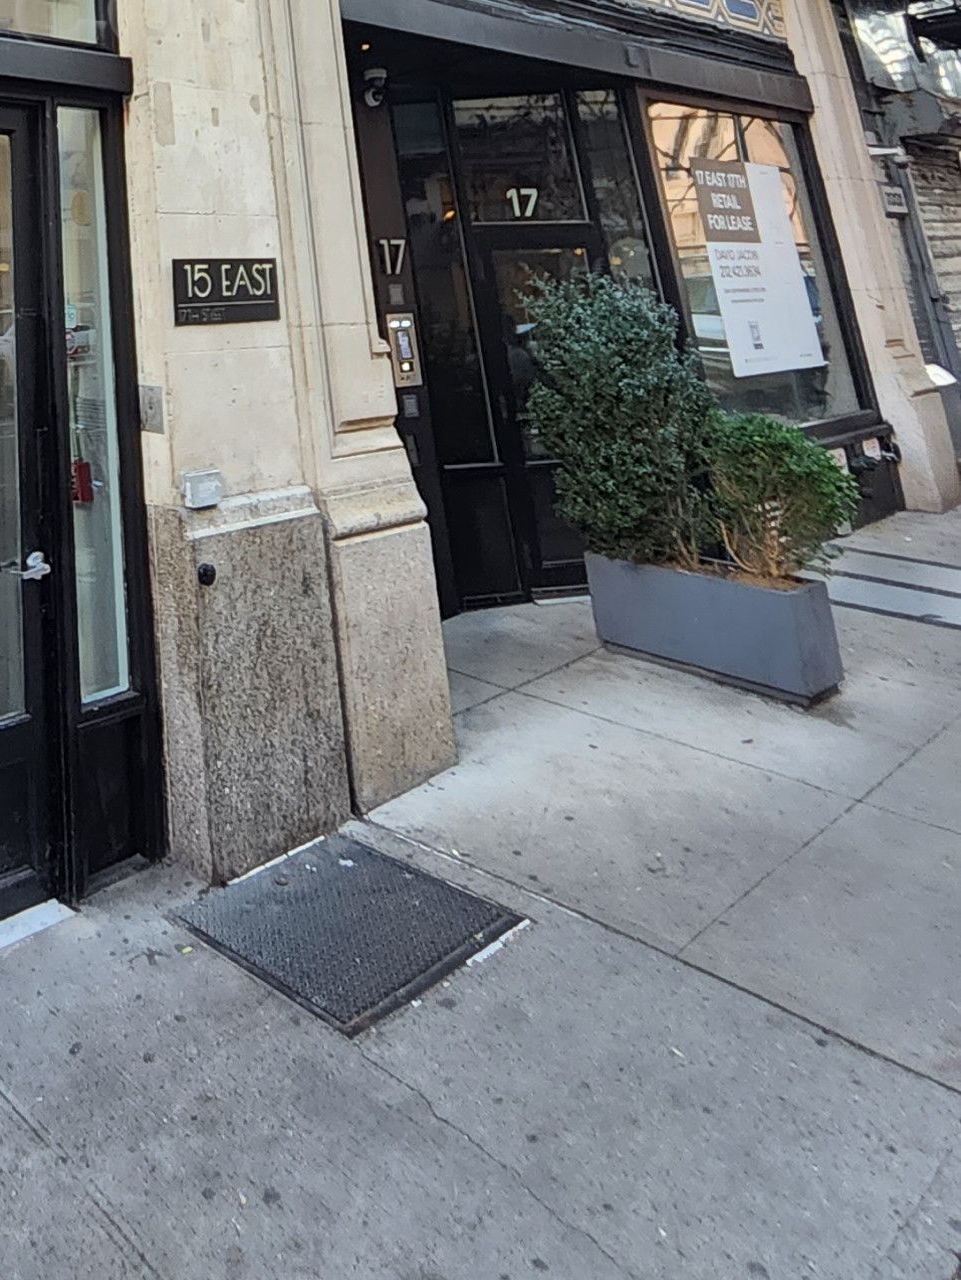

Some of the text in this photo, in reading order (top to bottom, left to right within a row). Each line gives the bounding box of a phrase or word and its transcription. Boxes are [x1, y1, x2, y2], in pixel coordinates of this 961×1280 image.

[695, 170, 747, 189] 17 EAST 17TH
[505, 188, 538, 217] 17
[711, 192, 741, 209] RETAIL
[707, 213, 754, 231] FOR LEASE
[378, 239, 406, 275] 17
[183, 263, 273, 297] 15 EAST
